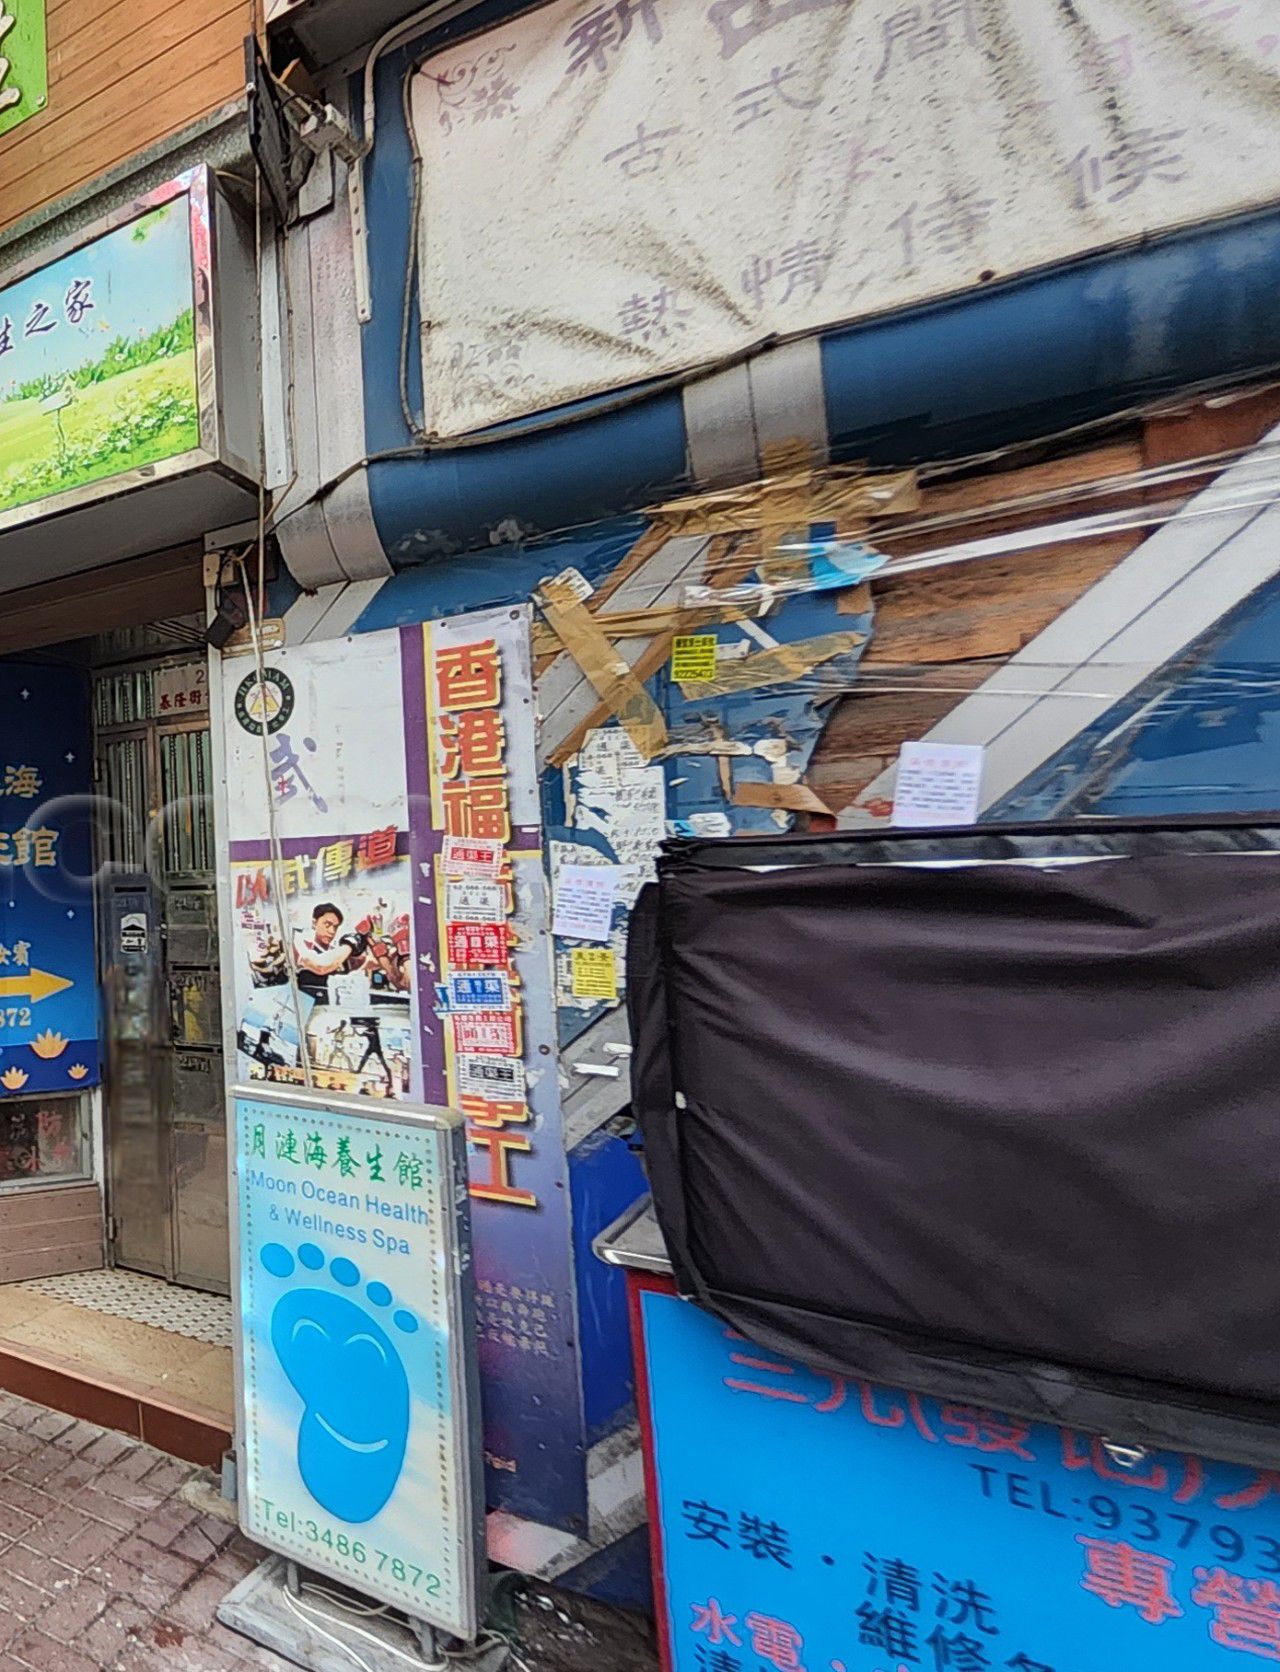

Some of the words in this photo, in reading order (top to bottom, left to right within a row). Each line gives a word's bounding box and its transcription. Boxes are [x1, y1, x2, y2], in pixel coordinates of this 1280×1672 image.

[160, 689, 208, 711] 基隆街
[251, 1123, 425, 1191] 月漣海養生館
[251, 1169, 298, 1196] Moon
[301, 1180, 360, 1211] Ocean
[365, 1193, 430, 1228] Health
[269, 1203, 280, 1223] &
[285, 1207, 368, 1245] Wellness
[372, 1228, 411, 1256] Spa
[374, 1551, 443, 1599] 7872
[1074, 1532, 1280, 1661] 專營
